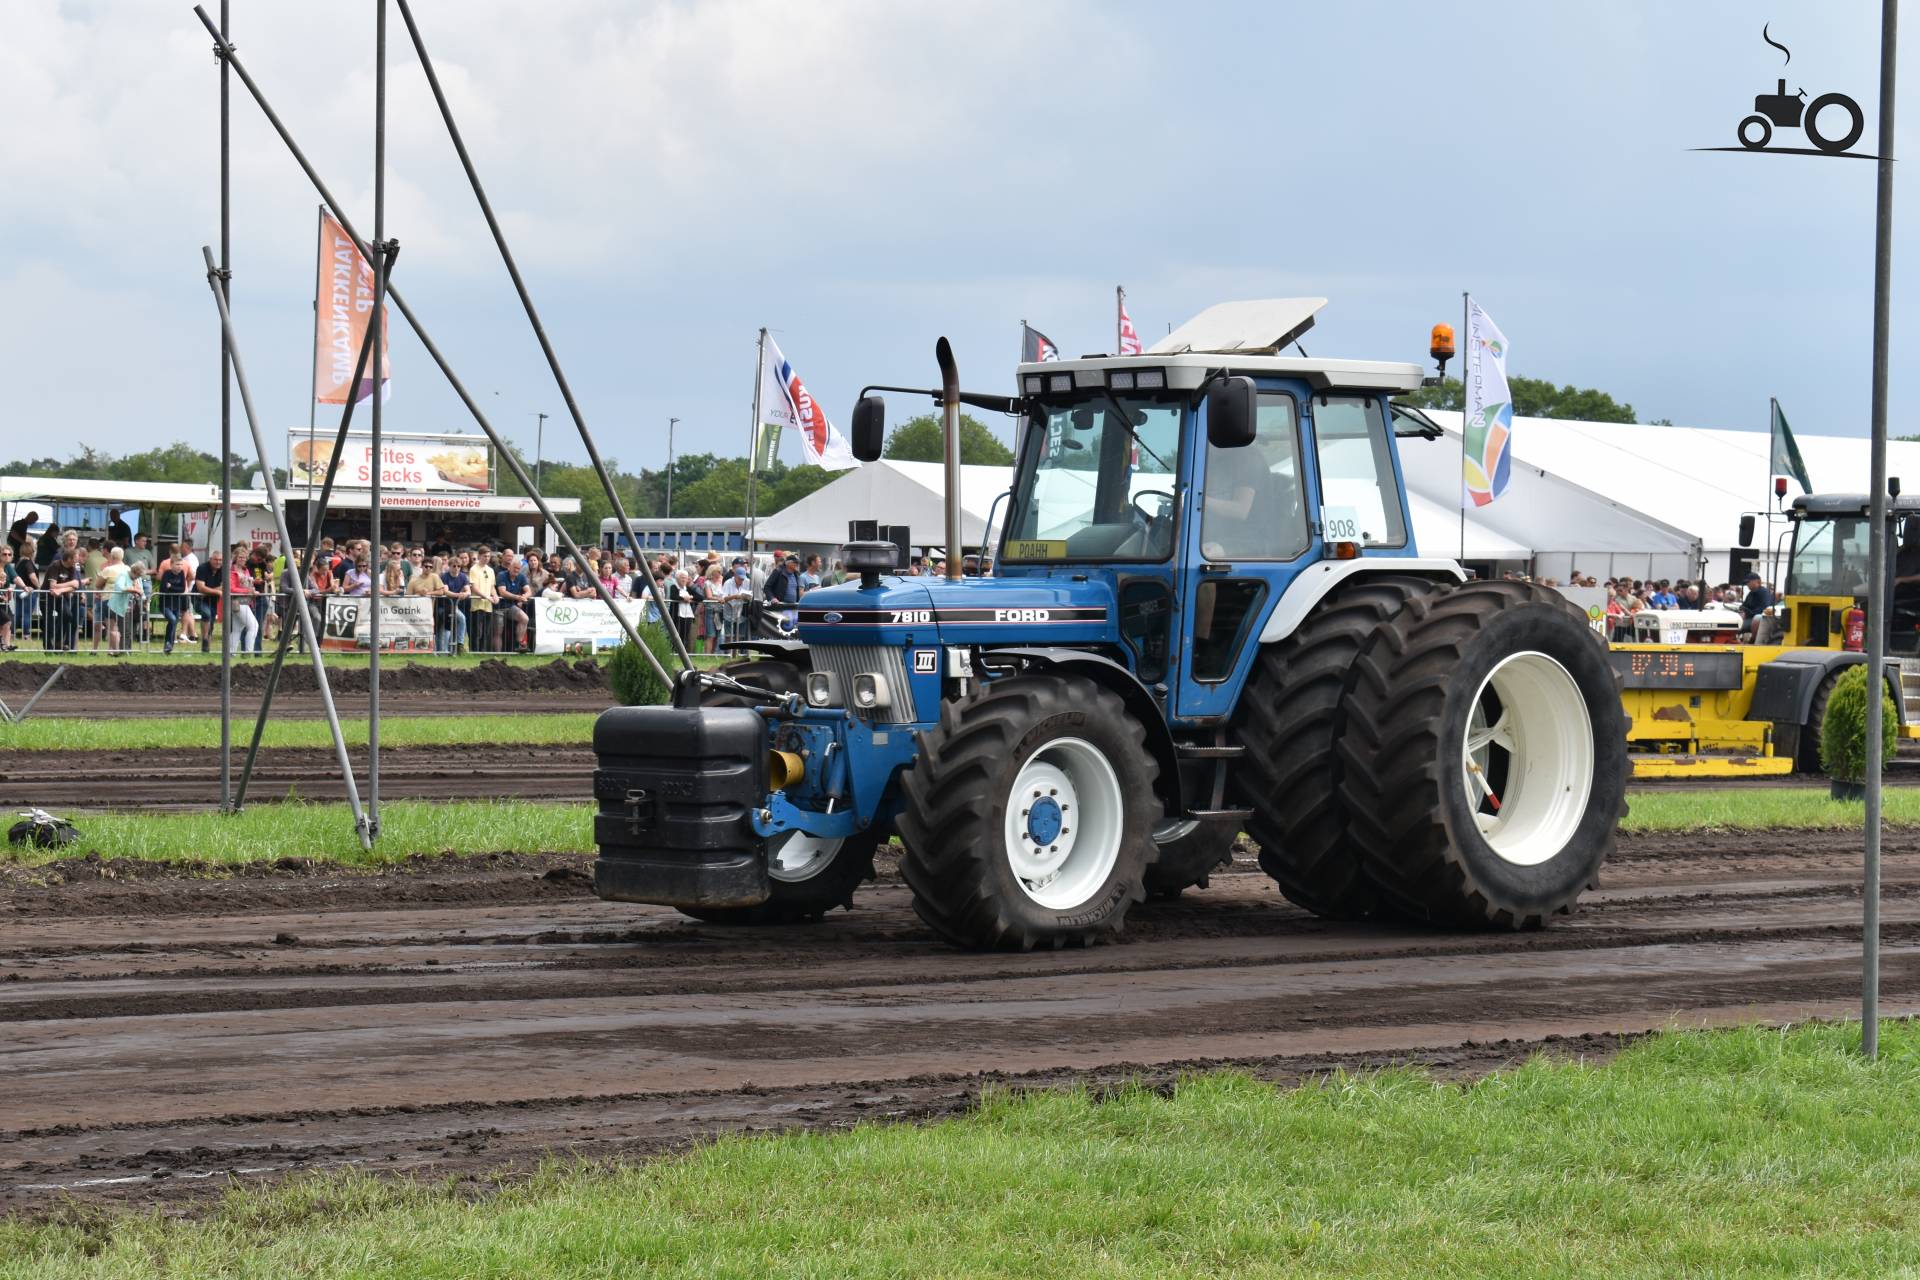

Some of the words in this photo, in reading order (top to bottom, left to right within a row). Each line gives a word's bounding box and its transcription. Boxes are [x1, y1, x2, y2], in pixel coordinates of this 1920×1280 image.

[365, 447, 415, 464] Fites
[358, 465, 422, 483] Sacks
[381, 497, 481, 508] venementenservice
[1329, 519, 1356, 538] 908
[391, 605, 421, 615] Gotink
[554, 607, 571, 622] RR
[890, 610, 931, 624] 7810
[995, 609, 1050, 622] FORD
[917, 653, 934, 669] III
